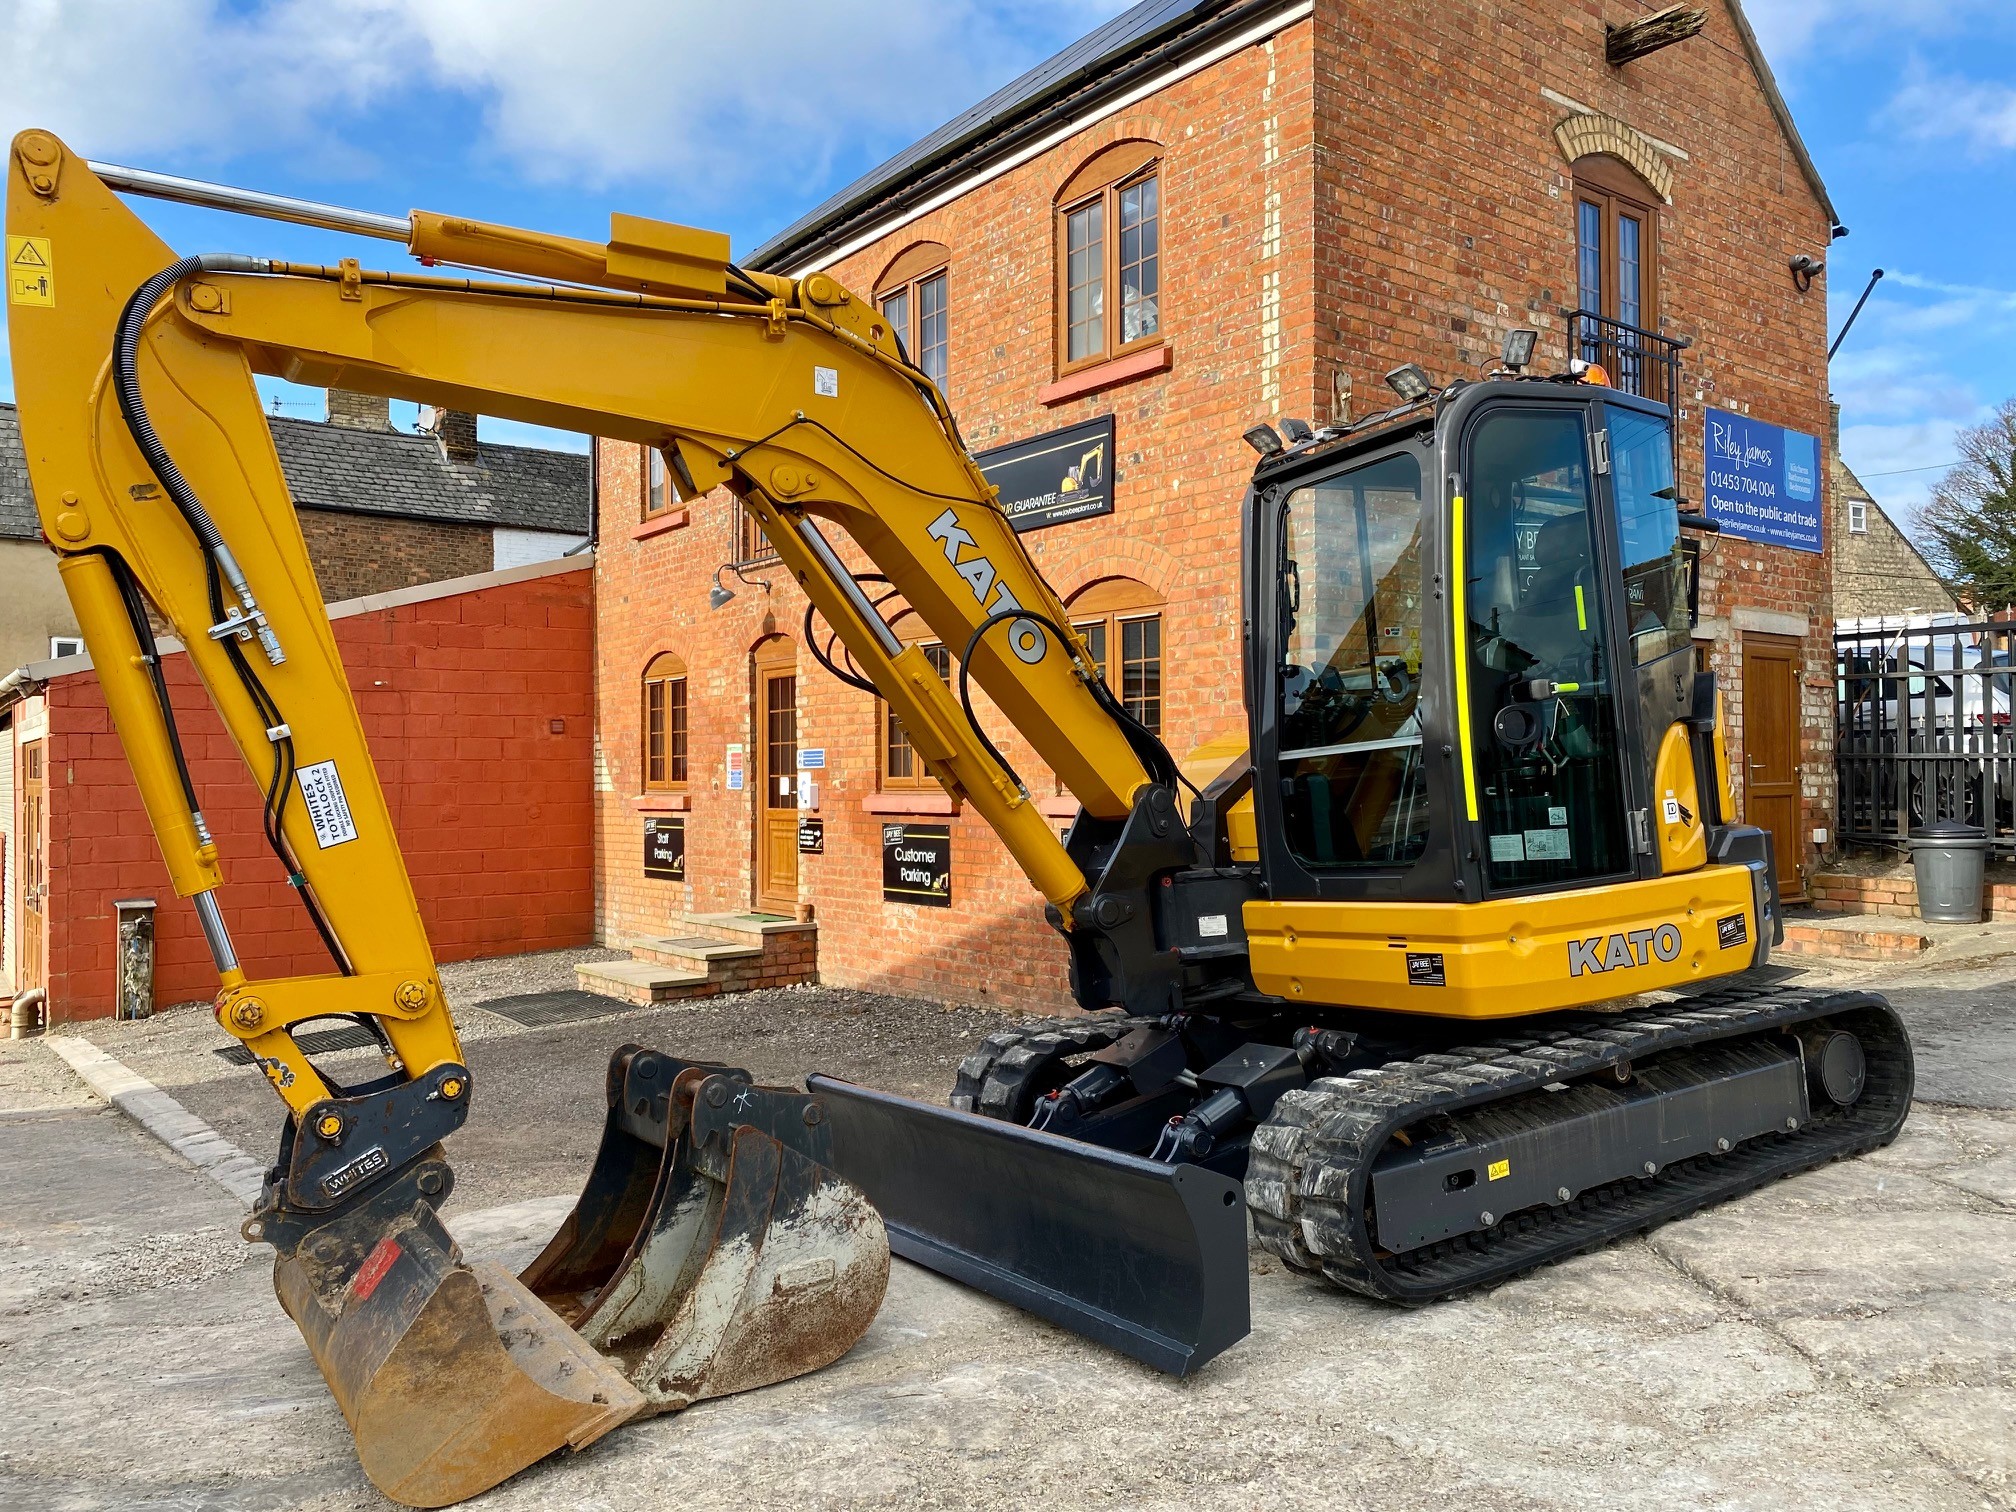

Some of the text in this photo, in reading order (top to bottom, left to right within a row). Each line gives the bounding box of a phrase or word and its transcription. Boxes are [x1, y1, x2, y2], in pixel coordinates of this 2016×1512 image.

[1711, 421, 1773, 471] Riley James
[1711, 471, 1775, 498] 01453 704 004
[1014, 493, 1056, 513] GUARANTEE
[1711, 495, 1817, 528] Open to the public and trade
[926, 506, 1047, 665] KATO
[327, 781, 336, 801] COUPLER
[304, 783, 325, 831] WHITES
[314, 777, 339, 840] TOTALOCK
[333, 801, 342, 820] LOCKING
[340, 804, 348, 819] SAFETY
[339, 820, 347, 836] DOUBLE
[657, 833, 669, 844] Staff
[654, 847, 673, 863] Parking
[894, 847, 936, 863] Customer
[901, 867, 931, 887] Parking
[1567, 923, 1683, 978] KATO
[329, 1153, 382, 1189] WHITES
